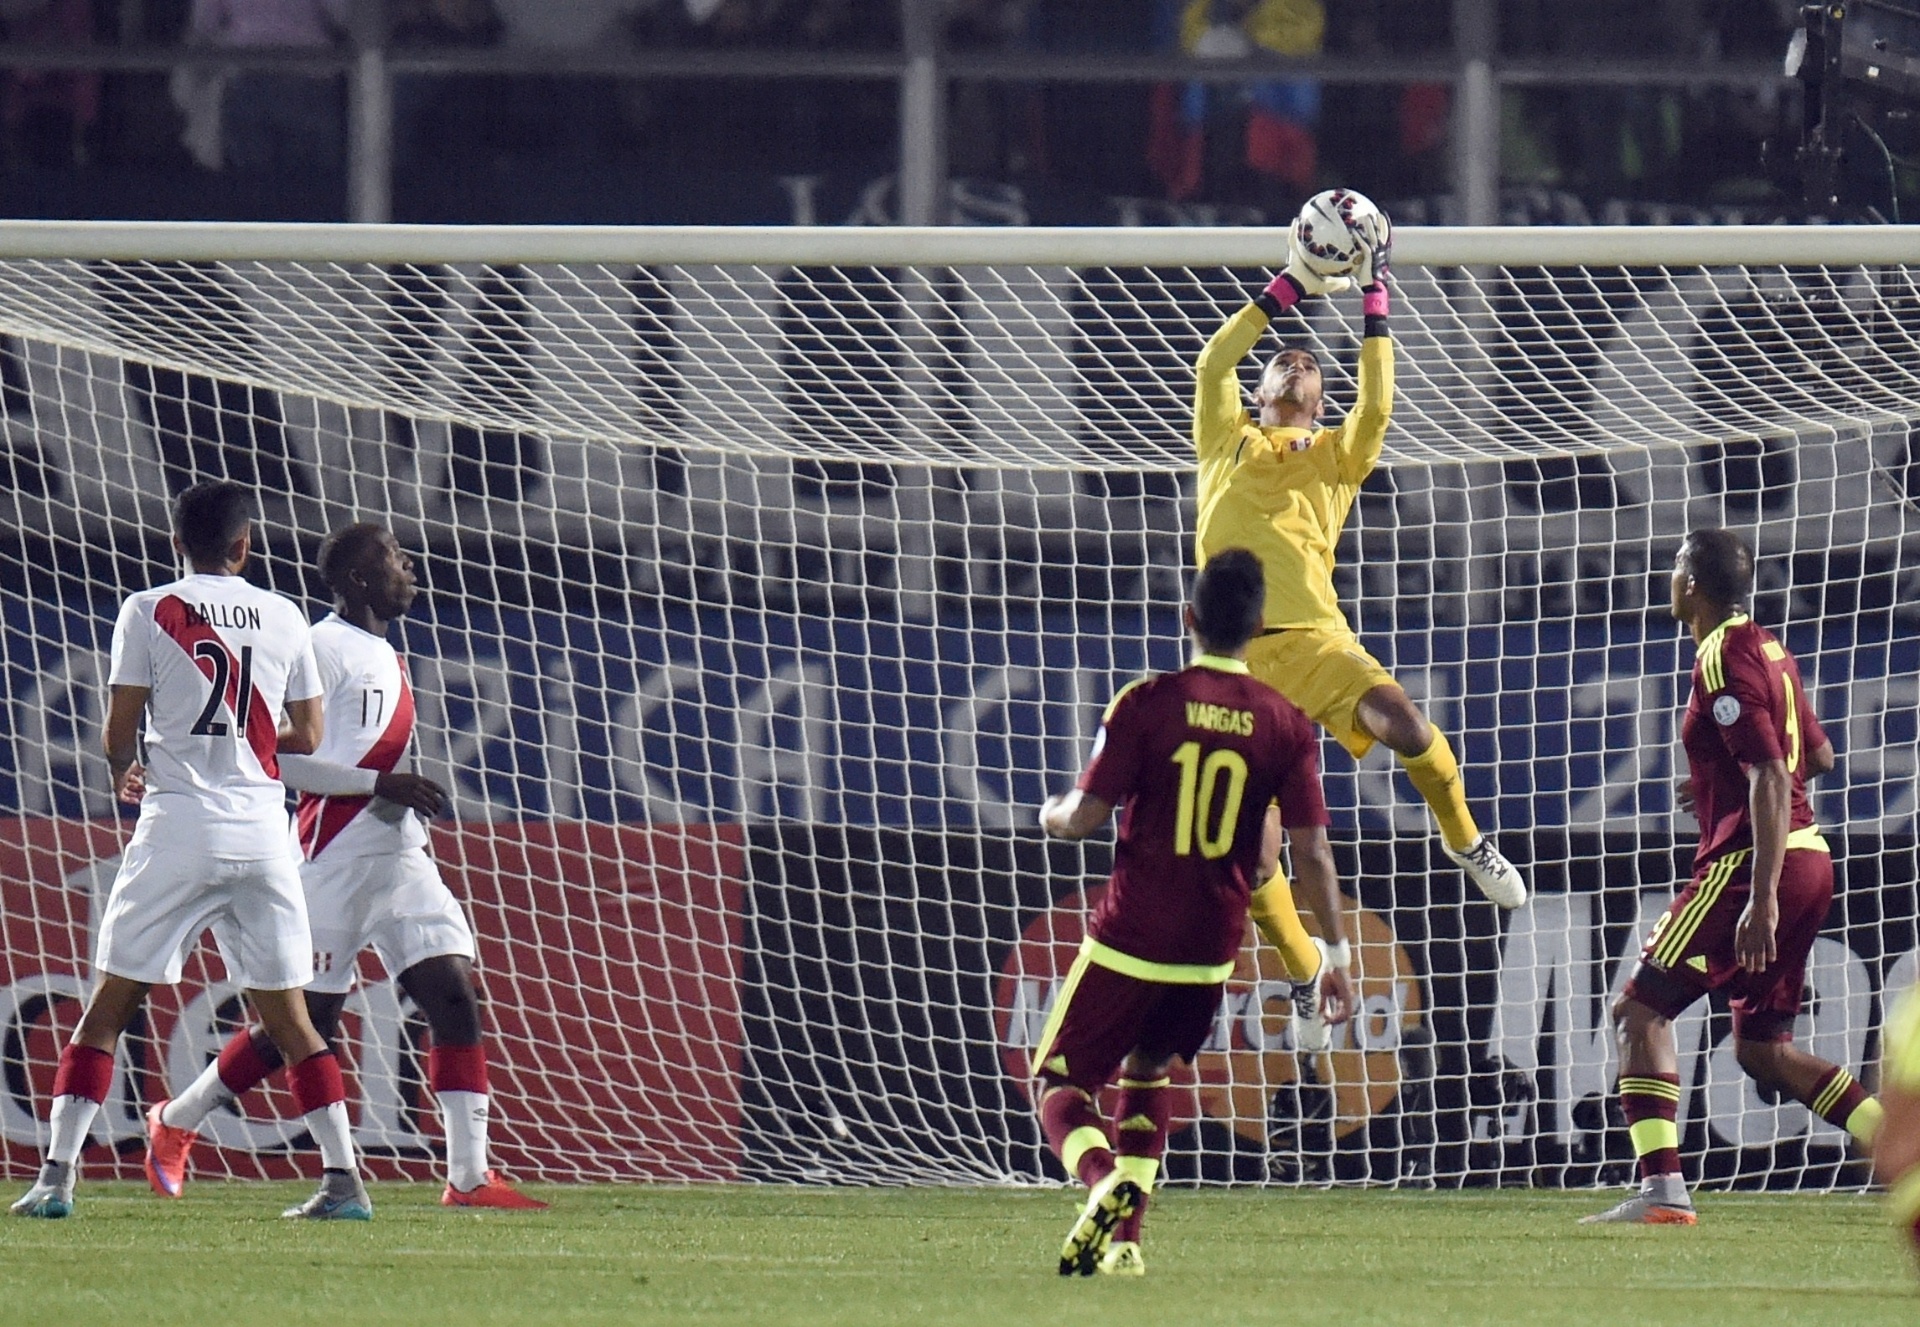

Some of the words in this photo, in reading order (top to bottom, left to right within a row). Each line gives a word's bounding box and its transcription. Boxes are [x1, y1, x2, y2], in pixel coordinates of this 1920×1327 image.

[185, 602, 261, 631] BALLON
[190, 639, 253, 738] 21
[361, 688, 384, 728] 17
[1185, 701, 1254, 737] VARGAS
[1170, 740, 1248, 860] 10
